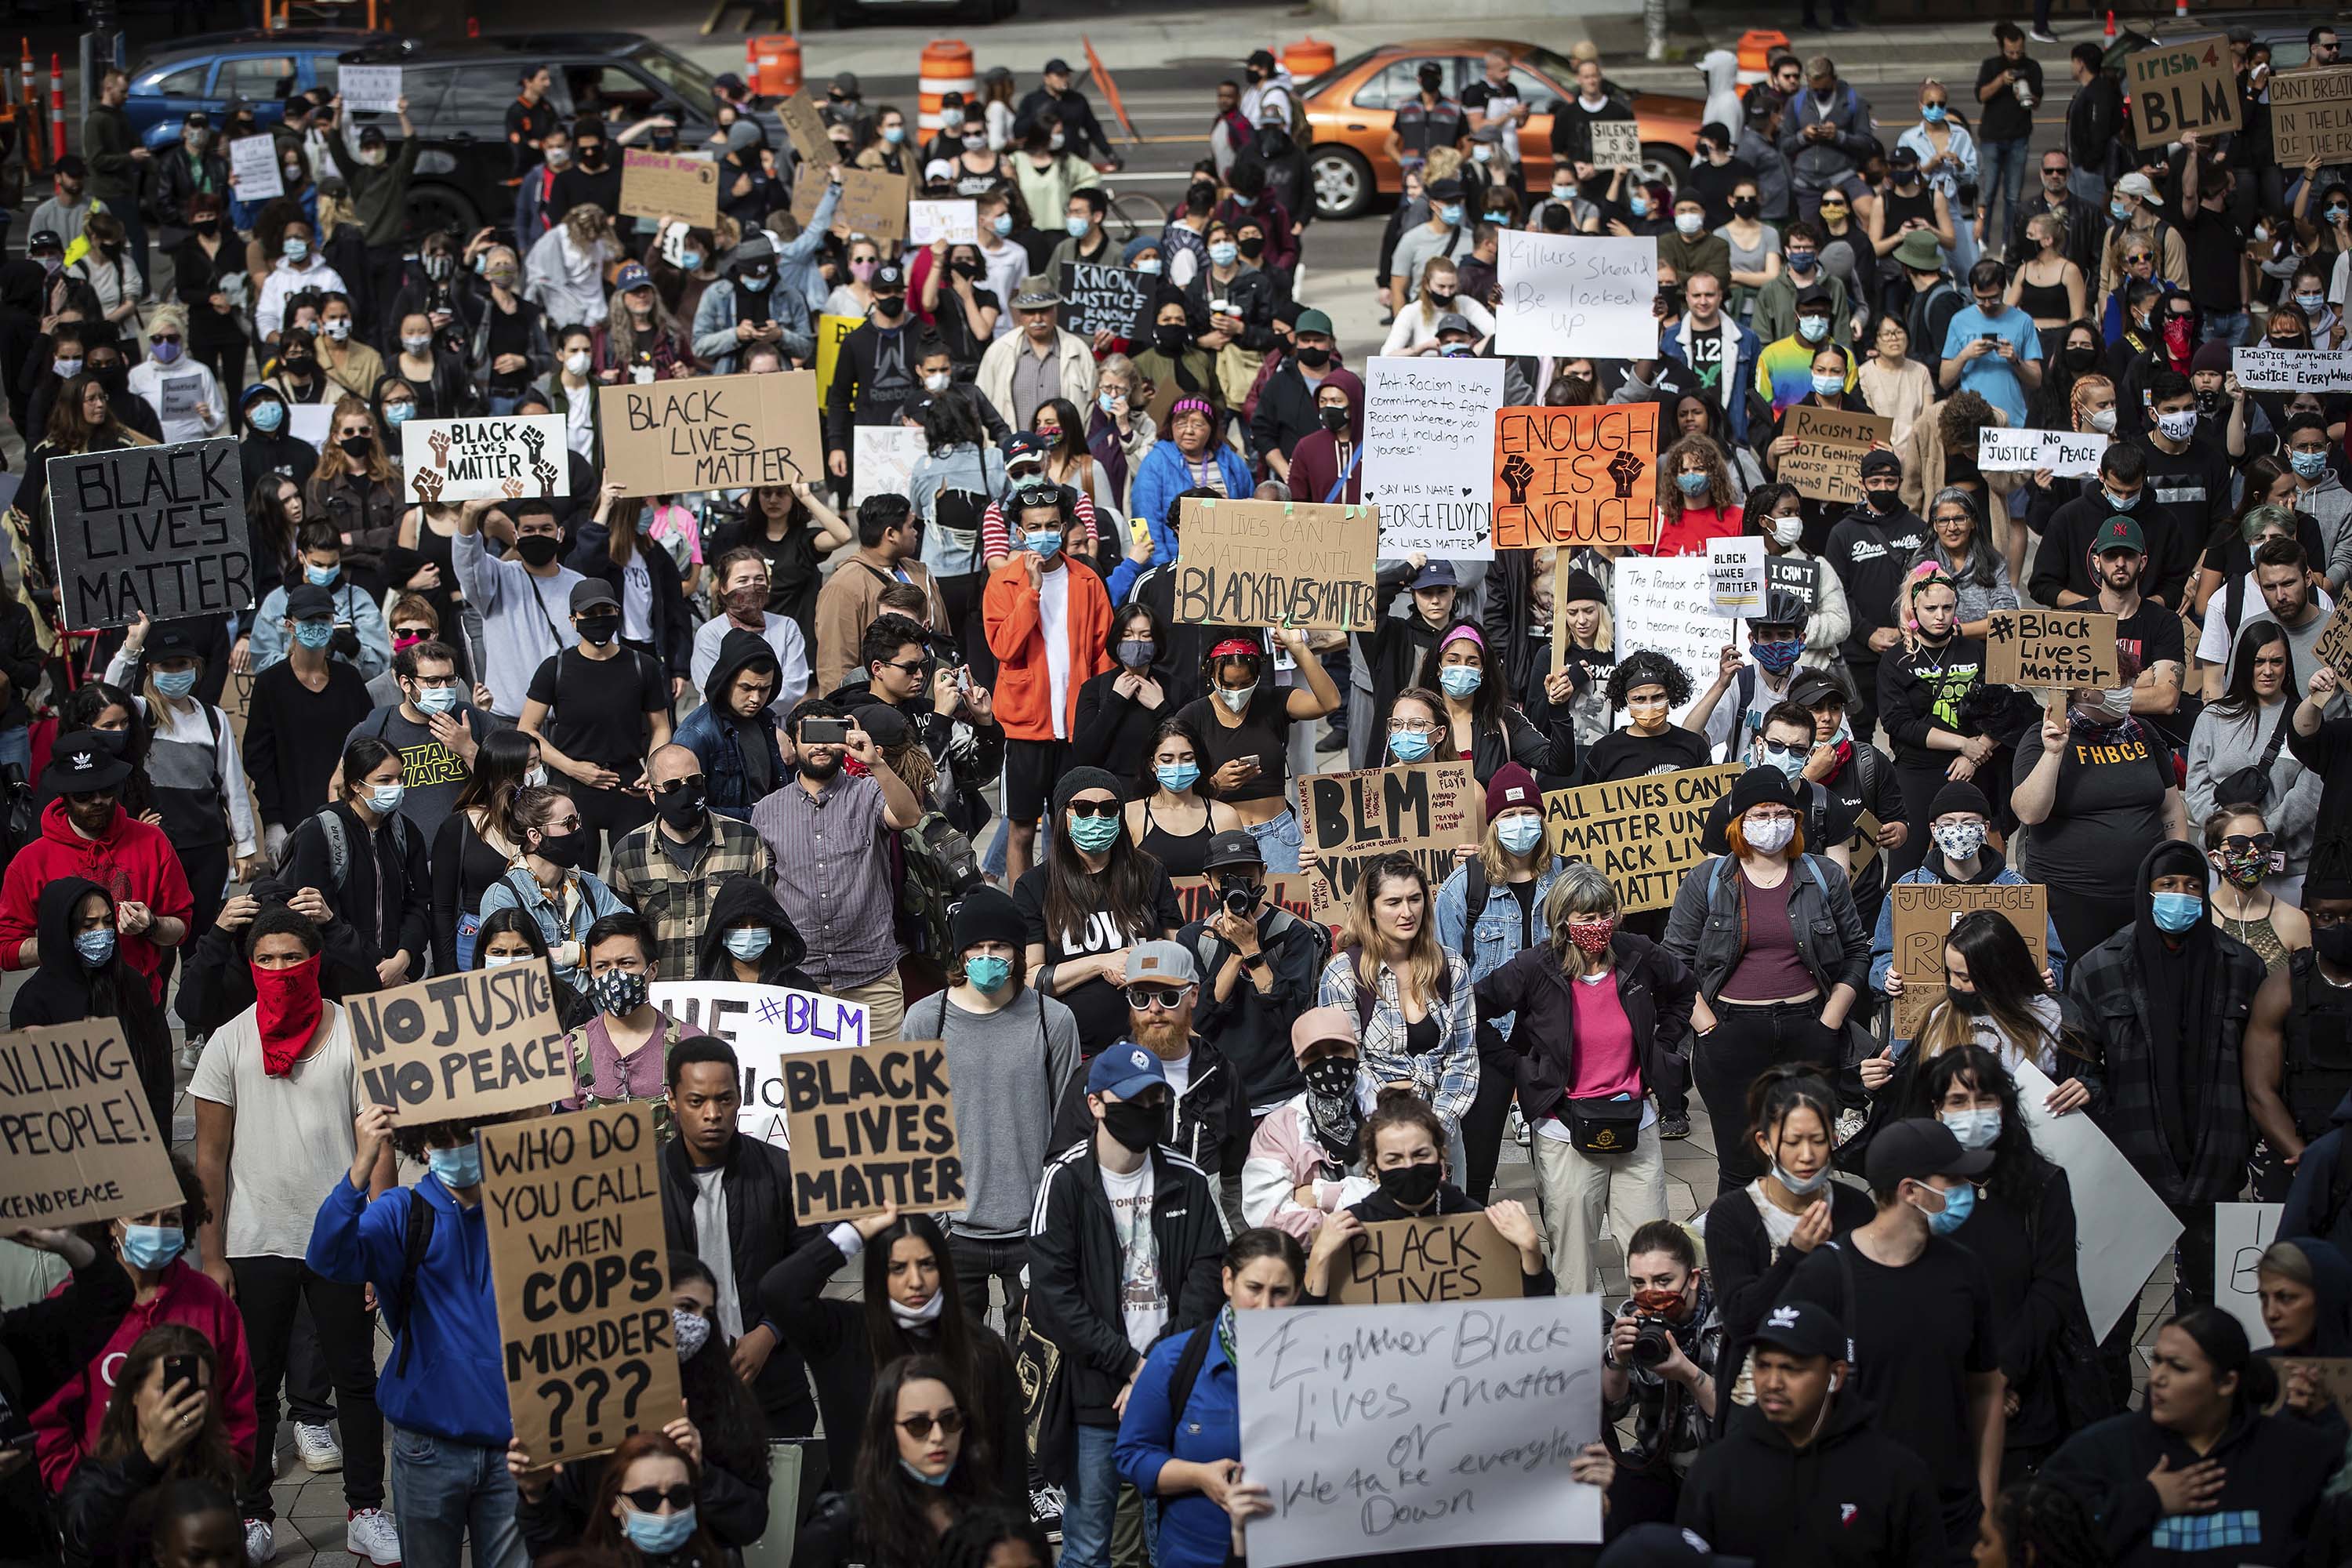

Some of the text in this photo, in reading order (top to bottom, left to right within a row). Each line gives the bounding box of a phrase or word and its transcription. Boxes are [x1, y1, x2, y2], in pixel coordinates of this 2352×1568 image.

[2201, 44, 2220, 68] 4
[2312, 74, 2352, 99] BREAT
[2141, 78, 2232, 135] BLM
[2280, 113, 2296, 132] IN
[2306, 110, 2334, 129] THE
[1594, 124, 1639, 138] SILENCE
[2280, 136, 2300, 154] OF
[2307, 134, 2334, 154] THE
[1073, 264, 1144, 294] KNOW
[1063, 290, 1148, 310] JUSTICE
[1514, 281, 1547, 314] Be
[1068, 315, 1136, 339] PEACE
[1083, 307, 1137, 322] KNOW
[1695, 338, 1722, 361] 12
[2280, 360, 2303, 370] threat
[1468, 381, 1492, 397] the
[626, 390, 729, 432] BLACK
[1368, 411, 1410, 423] Racism
[1461, 419, 1480, 431] you
[1458, 399, 1489, 417] fight
[451, 422, 517, 445] BLACK
[670, 423, 757, 456] LIVES
[1501, 410, 1657, 454] ENOUGH
[1856, 426, 1875, 441] IS
[462, 442, 507, 456] LIVES
[1987, 446, 2039, 462] JUSTICE
[2059, 445, 2096, 463] PEACE
[75, 448, 232, 514] BLACK
[448, 454, 522, 481] MATTER
[695, 447, 804, 487] MATTER
[1544, 455, 1595, 496] IS
[1378, 484, 1455, 496] SAY HIS NAME
[83, 502, 229, 560] LIVES
[1188, 506, 1349, 546] ALL LIVES CAN'T
[1496, 497, 1653, 545] ENOUGH
[1189, 541, 1360, 575] MATTER UNTIL
[1400, 539, 1476, 550] LIVES MATTER
[1714, 553, 1747, 564] BLACK
[77, 551, 253, 625] MATTER
[1628, 570, 1646, 587] The
[1653, 570, 1686, 590] Paradox
[1715, 568, 1744, 579] LIVES
[1716, 581, 1759, 593] MATTER
[1771, 564, 1813, 584] I CAN'T
[1645, 594, 1667, 609] that
[1673, 601, 1686, 612] as
[1627, 619, 1638, 630] to
[1646, 620, 1679, 633] become
[1687, 645, 1697, 659] to
[1701, 645, 1720, 660] Exa
[2020, 640, 2092, 665] Lives
[2019, 662, 2111, 685] Matter
[1330, 768, 1381, 779] WALTER SCOTT
[1312, 770, 1431, 850] BLM
[1548, 792, 1591, 823] ALL
[1600, 782, 1672, 814] LIVES
[330, 825, 340, 841] AIR
[1560, 812, 1664, 854] MATTER
[333, 844, 343, 866] MAX
[1311, 881, 1321, 913] SANDRA
[1318, 877, 1330, 909] BLAND
[1898, 885, 2034, 911] JUSTICE
[1061, 910, 1147, 956] LOV
[350, 967, 551, 1060] NO JUSTICE
[754, 993, 864, 1047] #BLM
[361, 1033, 568, 1115] NO PEACE
[784, 1047, 951, 1114] BLACK
[0, 1089, 152, 1156] PEOPLE!
[815, 1104, 956, 1161] LIVES
[485, 1112, 641, 1176] WHO DO
[491, 1163, 658, 1229] YOU CALL
[797, 1155, 966, 1216] MATTER
[528, 1213, 624, 1264] WHEN
[1349, 1219, 1483, 1285] BLACK
[522, 1249, 664, 1323] COPS
[1370, 1264, 1483, 1303] LIVES
[506, 1307, 673, 1383] MURDER
[1452, 1308, 1573, 1370] Black
[1387, 1422, 1453, 1469] or
[1448, 1425, 1592, 1474] everythin
[1361, 1489, 1475, 1537] Down
